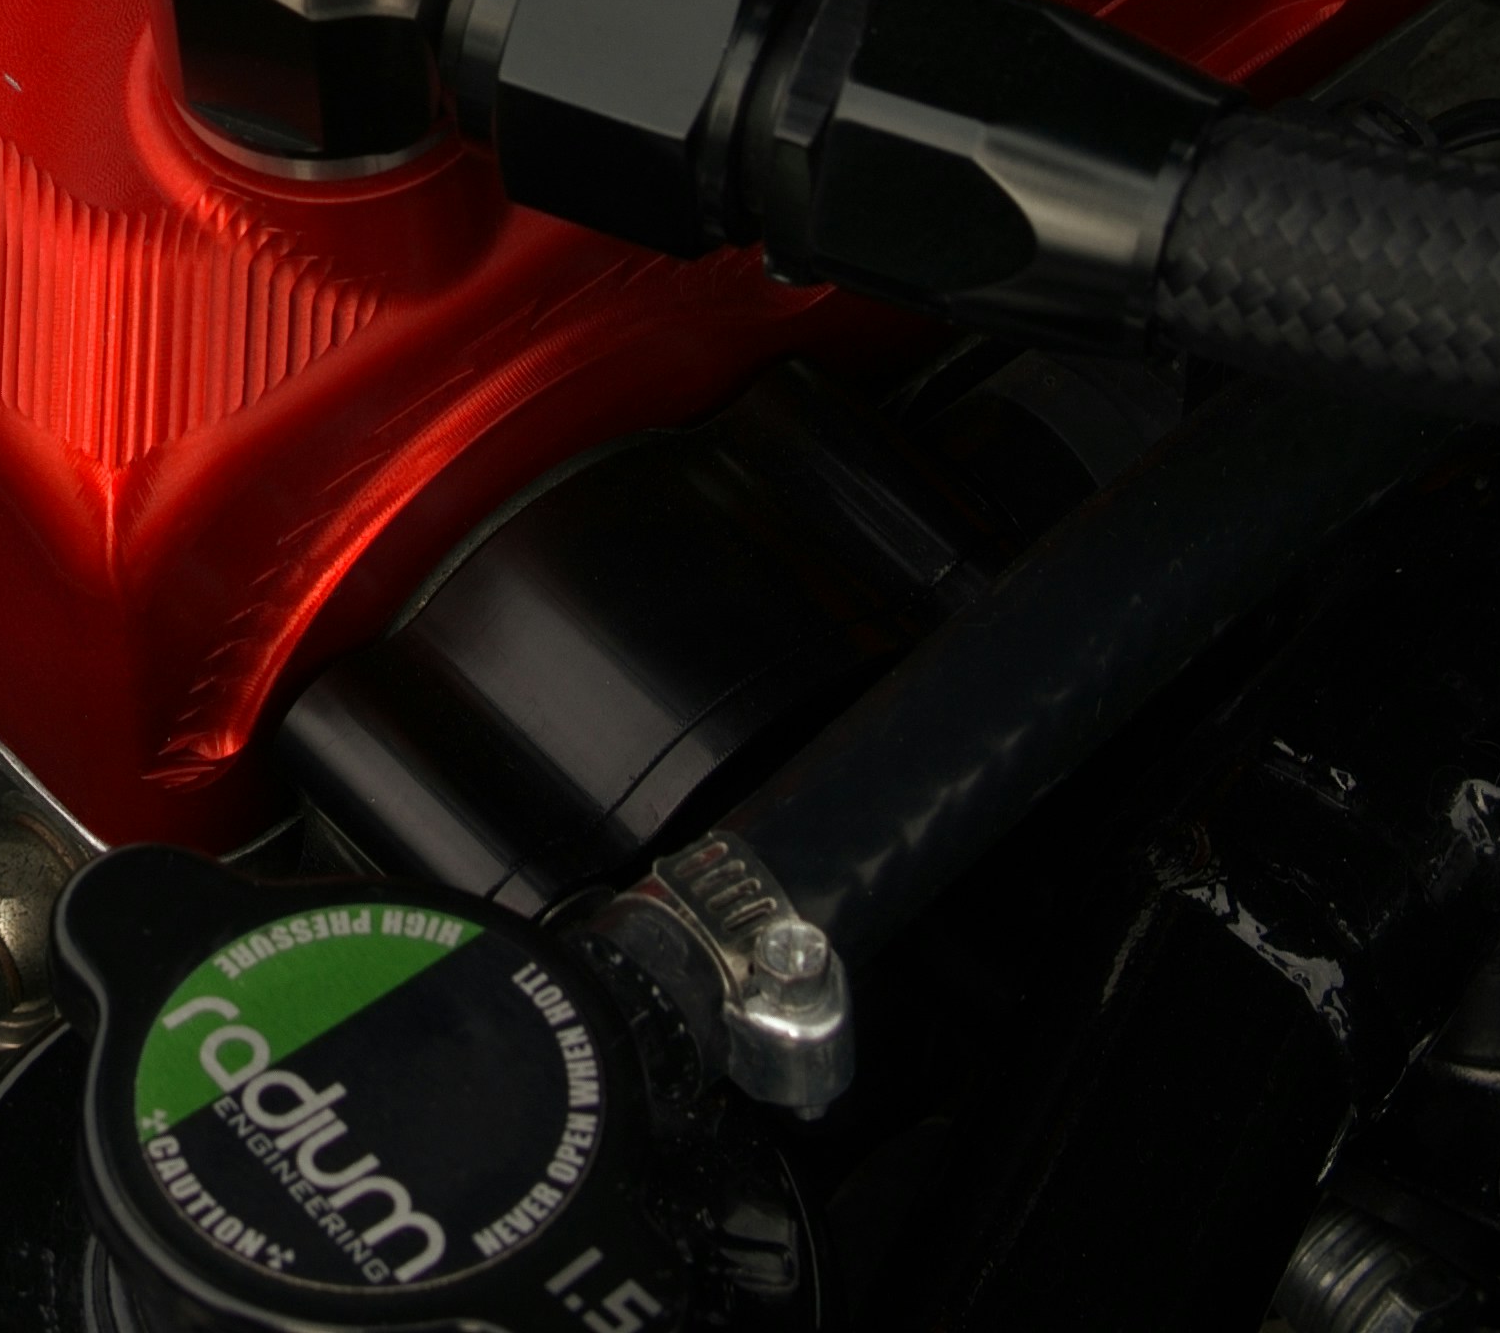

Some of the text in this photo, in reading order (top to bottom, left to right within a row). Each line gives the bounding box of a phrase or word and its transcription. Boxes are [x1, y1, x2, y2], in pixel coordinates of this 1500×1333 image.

[213, 909, 463, 980] HIGH PRESSURE
[161, 995, 447, 1284] radium
[471, 961, 600, 1259] NEVER OPEN WHEN HOT!
[147, 1135, 268, 1259] CAUTION
[212, 1094, 392, 1285] ENGINEERING
[544, 1245, 664, 1333] 1.5
